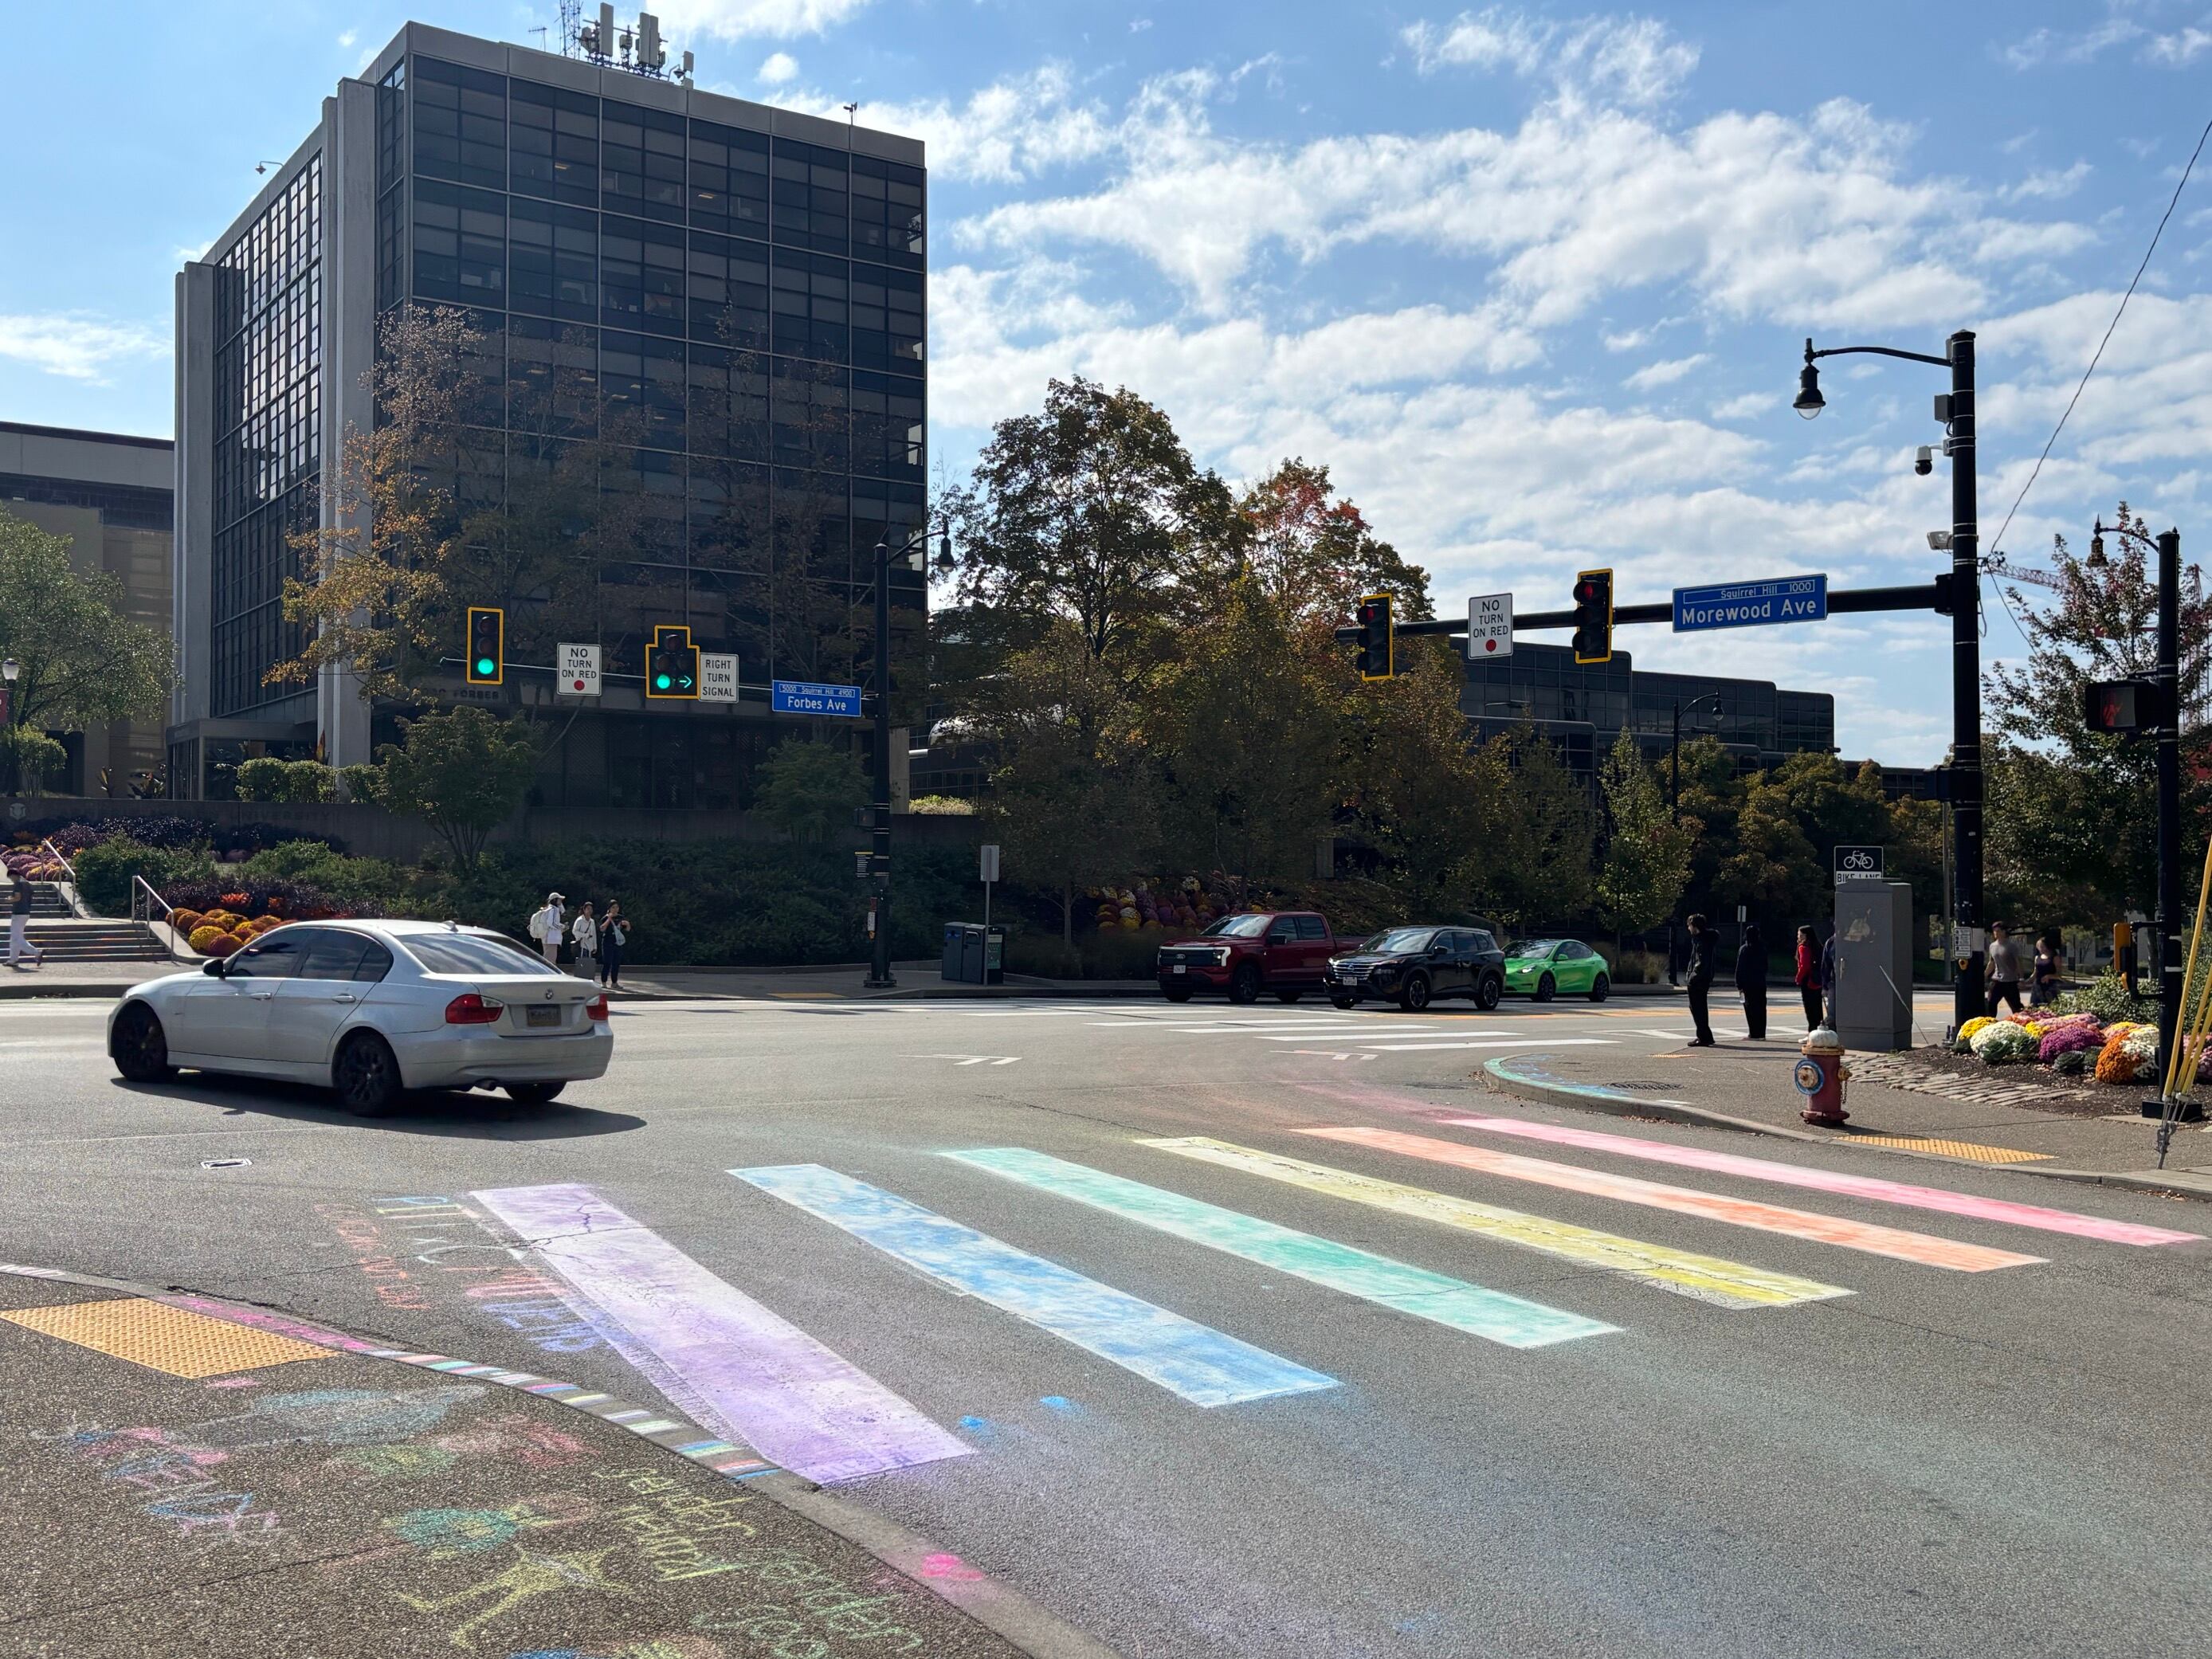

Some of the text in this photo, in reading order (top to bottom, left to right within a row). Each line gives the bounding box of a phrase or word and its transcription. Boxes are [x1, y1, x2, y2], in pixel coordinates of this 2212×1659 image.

[1720, 582, 1811, 599] Squirrel Hill 1000
[1482, 599, 1500, 612] NO
[1682, 598, 1816, 625] Morewood Ave
[1479, 613, 1504, 625] TURN
[1473, 626, 1508, 637] ON RED
[571, 648, 588, 657] NO
[567, 659, 592, 668] TURN
[705, 659, 731, 669] RIGHT
[707, 673, 731, 683] TURN
[702, 686, 735, 697] SIGNAL
[801, 686, 822, 696] Squirrel
[787, 696, 846, 711] Forbes Ave
